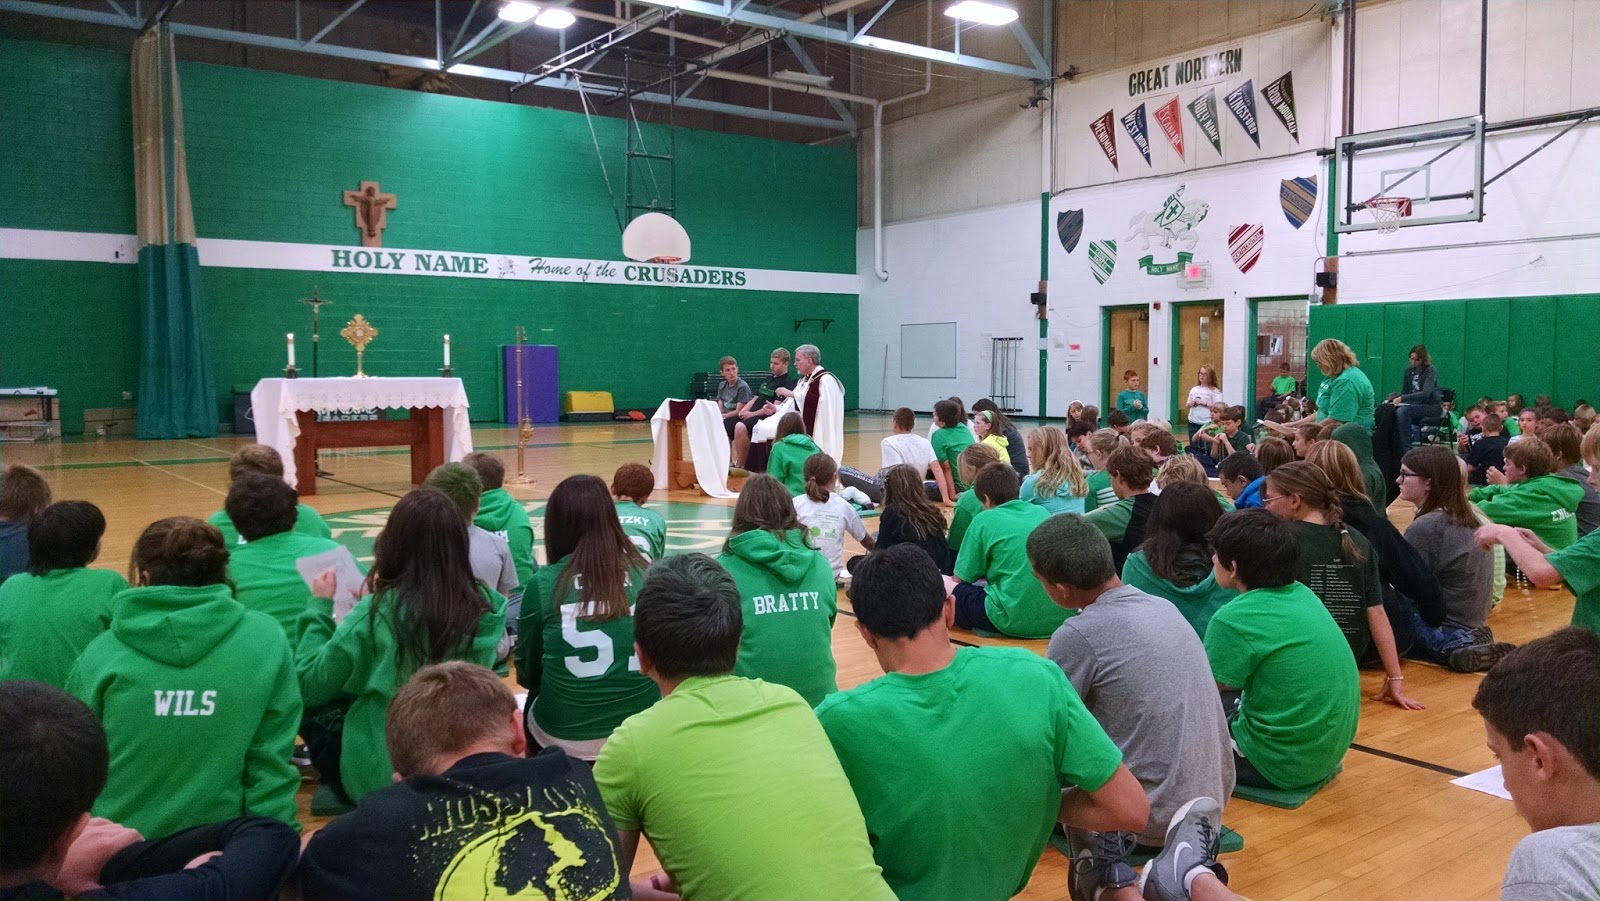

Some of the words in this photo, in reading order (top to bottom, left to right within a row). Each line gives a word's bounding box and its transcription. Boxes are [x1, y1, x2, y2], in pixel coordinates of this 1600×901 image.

[1128, 65, 1170, 97] GREAT
[1124, 109, 1138, 135] WEST
[1160, 105, 1181, 146] ESCANABA
[1194, 93, 1210, 122] HOLY
[1203, 119, 1219, 143] NAME
[1228, 88, 1257, 134] KINGSFORD
[1267, 80, 1282, 107] IRON
[1276, 101, 1297, 134] MOUNTAIN
[1094, 117, 1117, 161] MENOMINEE
[331, 249, 405, 270] HOLY
[415, 254, 489, 274] NAME
[528, 257, 571, 277] Home
[576, 262, 592, 282] of
[595, 262, 617, 278] the
[624, 265, 746, 286] CRUSADERS
[752, 591, 819, 615] BRATTY
[560, 600, 641, 678] 5
[154, 690, 218, 716] WILS
